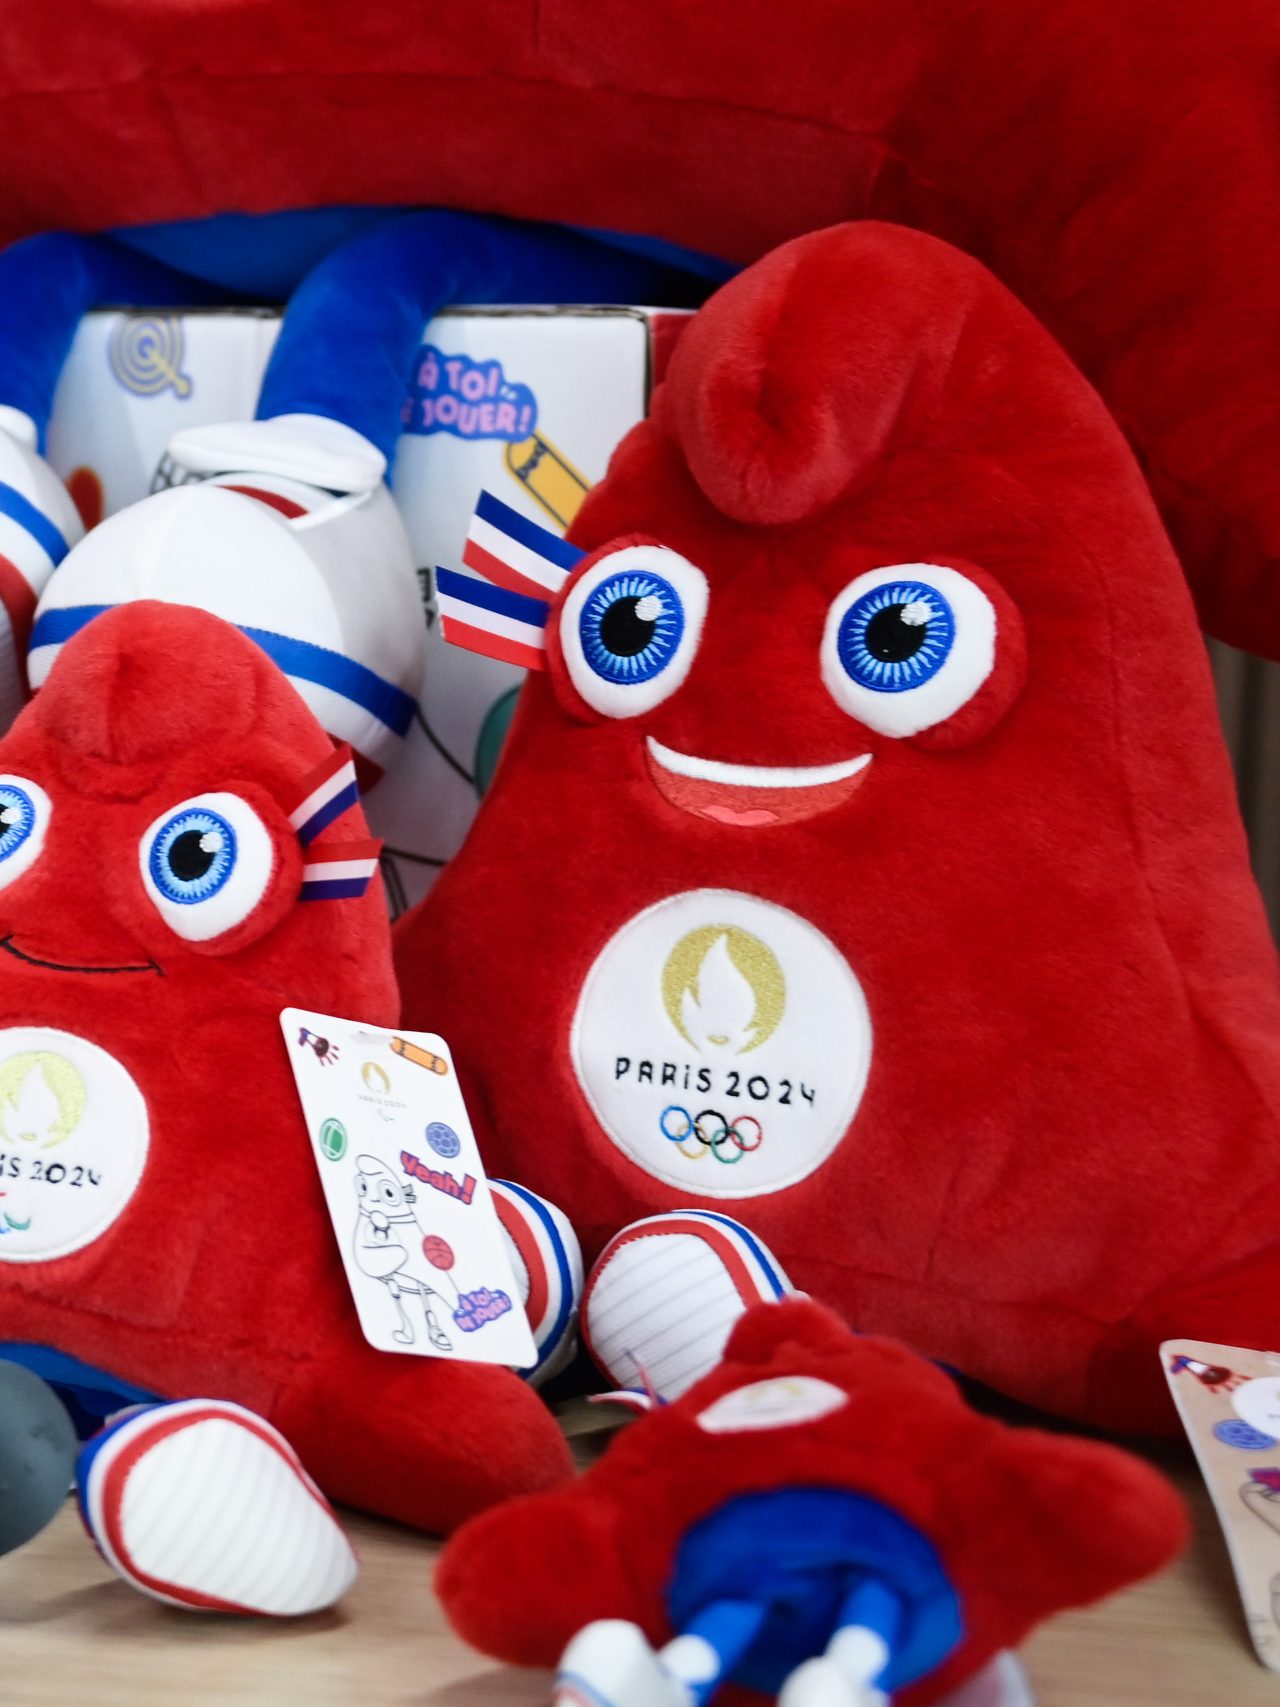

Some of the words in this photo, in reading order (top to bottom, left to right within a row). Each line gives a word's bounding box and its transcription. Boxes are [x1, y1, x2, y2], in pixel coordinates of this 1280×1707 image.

[422, 394, 532, 434] JOUER!
[726, 1071, 816, 1108] 2024
[29, 1160, 102, 1188] 2024
